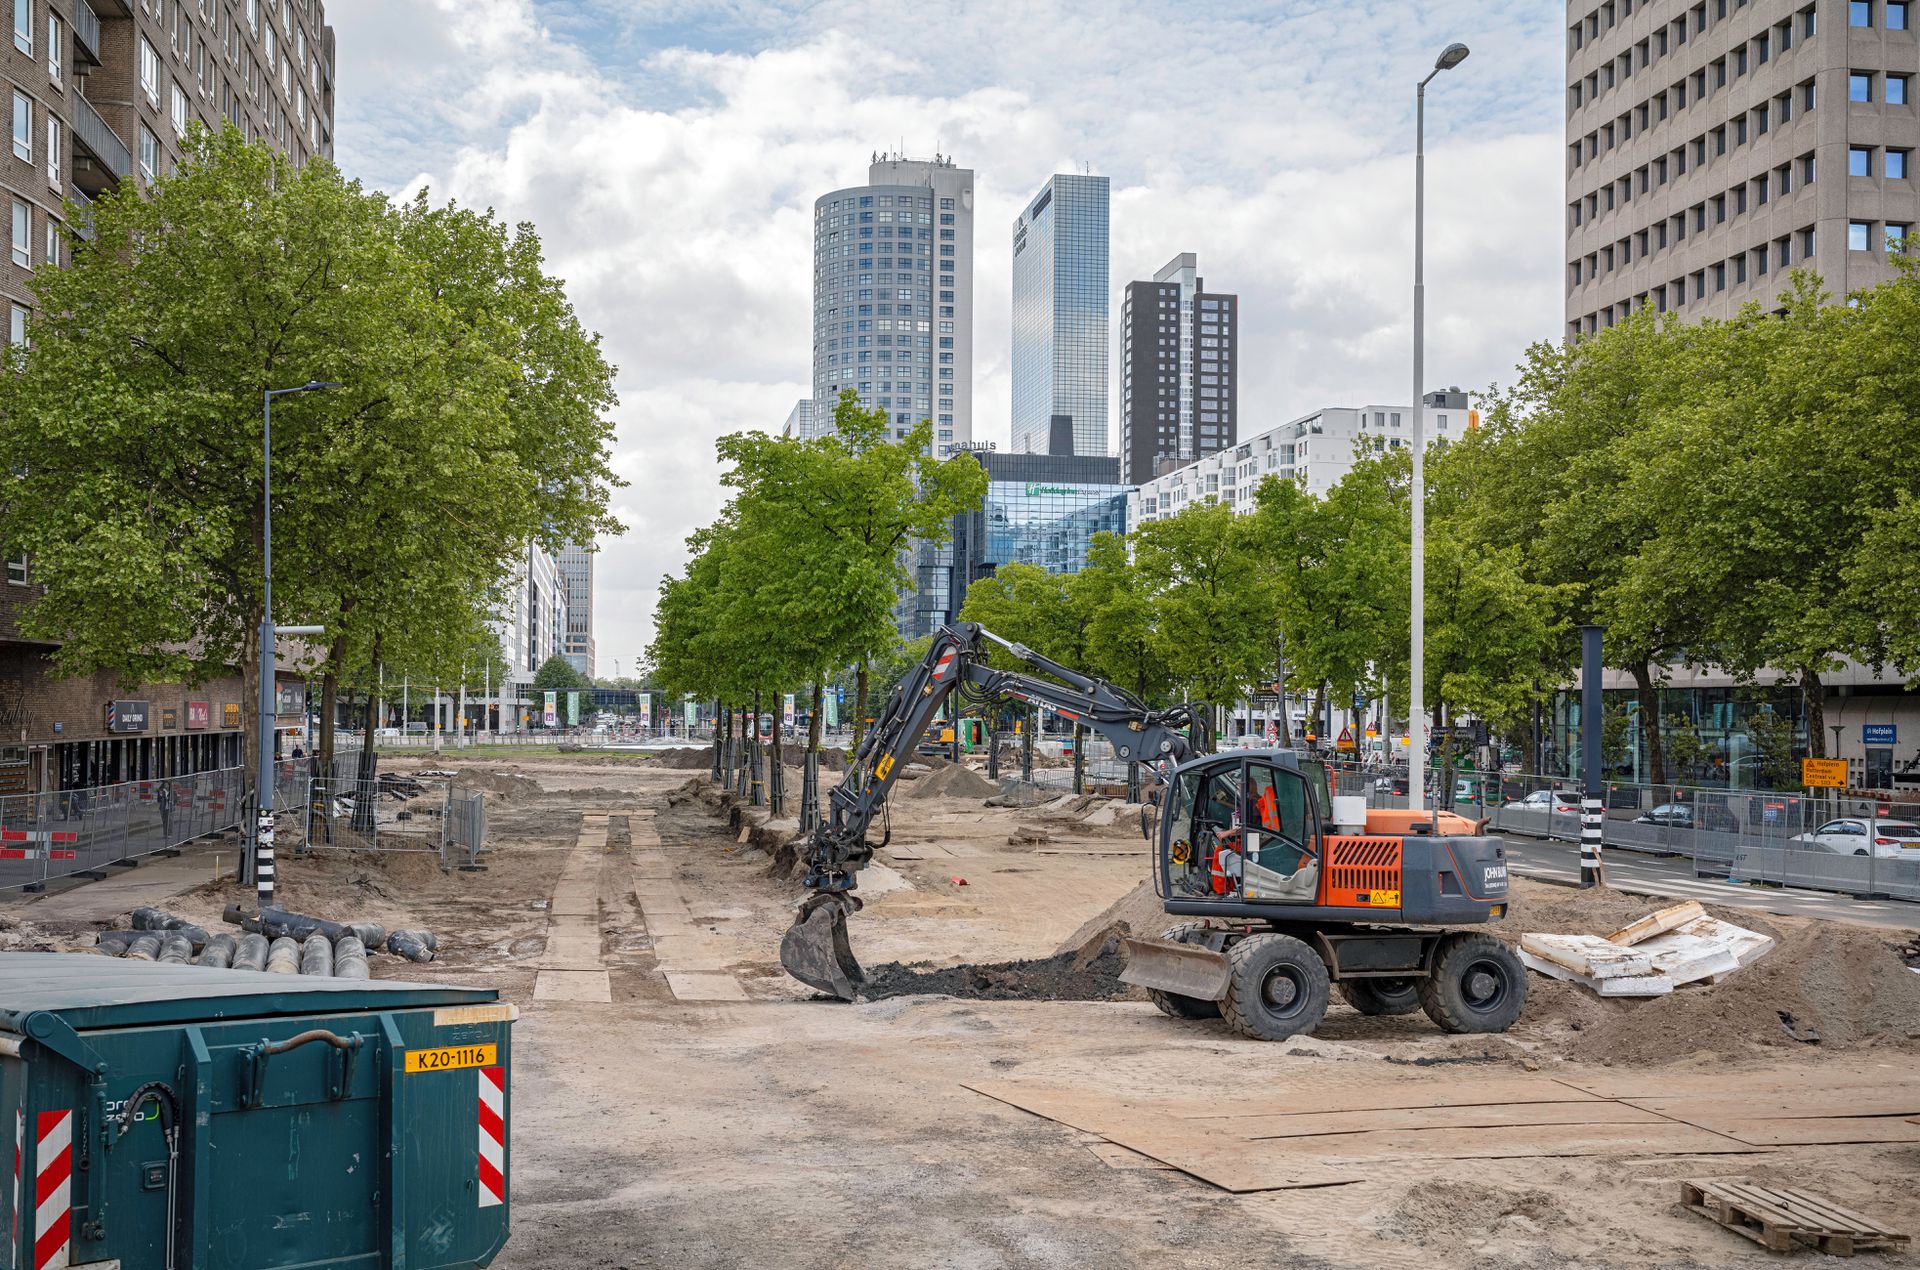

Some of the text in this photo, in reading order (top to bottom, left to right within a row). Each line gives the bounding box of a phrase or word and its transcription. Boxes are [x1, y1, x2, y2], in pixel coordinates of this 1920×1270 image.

[1872, 727, 1893, 735] Hofplein
[1484, 867, 1498, 882] JOHN
[419, 1048, 485, 1069] K20-1116
[106, 1111, 145, 1122] zeo
